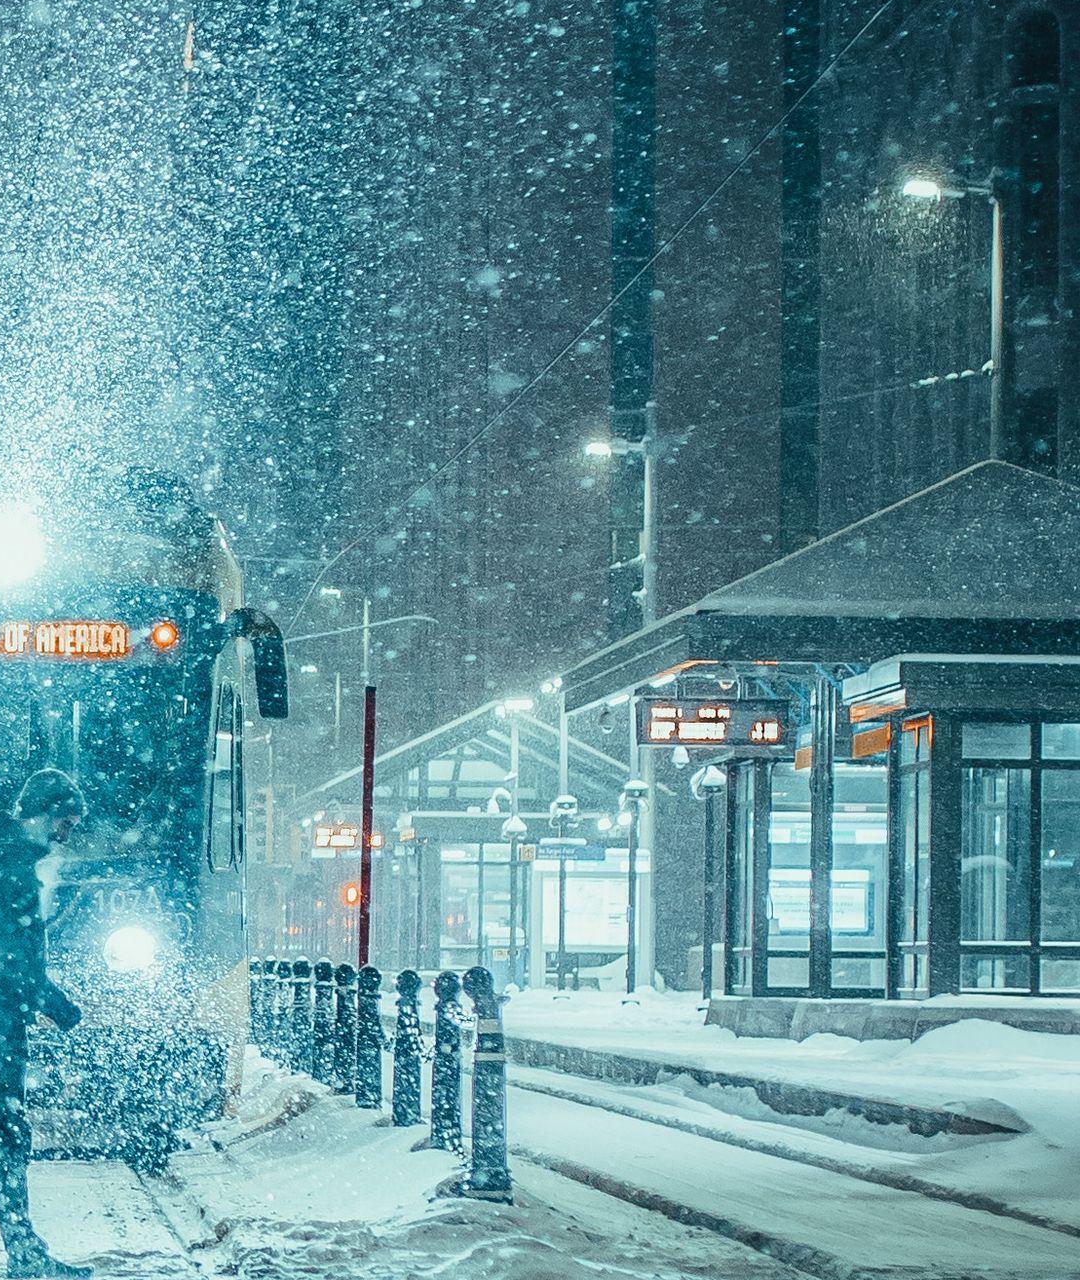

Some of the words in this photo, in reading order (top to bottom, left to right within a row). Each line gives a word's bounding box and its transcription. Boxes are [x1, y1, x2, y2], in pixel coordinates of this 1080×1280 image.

[3, 622, 29, 652] OF
[36, 623, 126, 652] AMERICA
[94, 886, 163, 914] 107A
